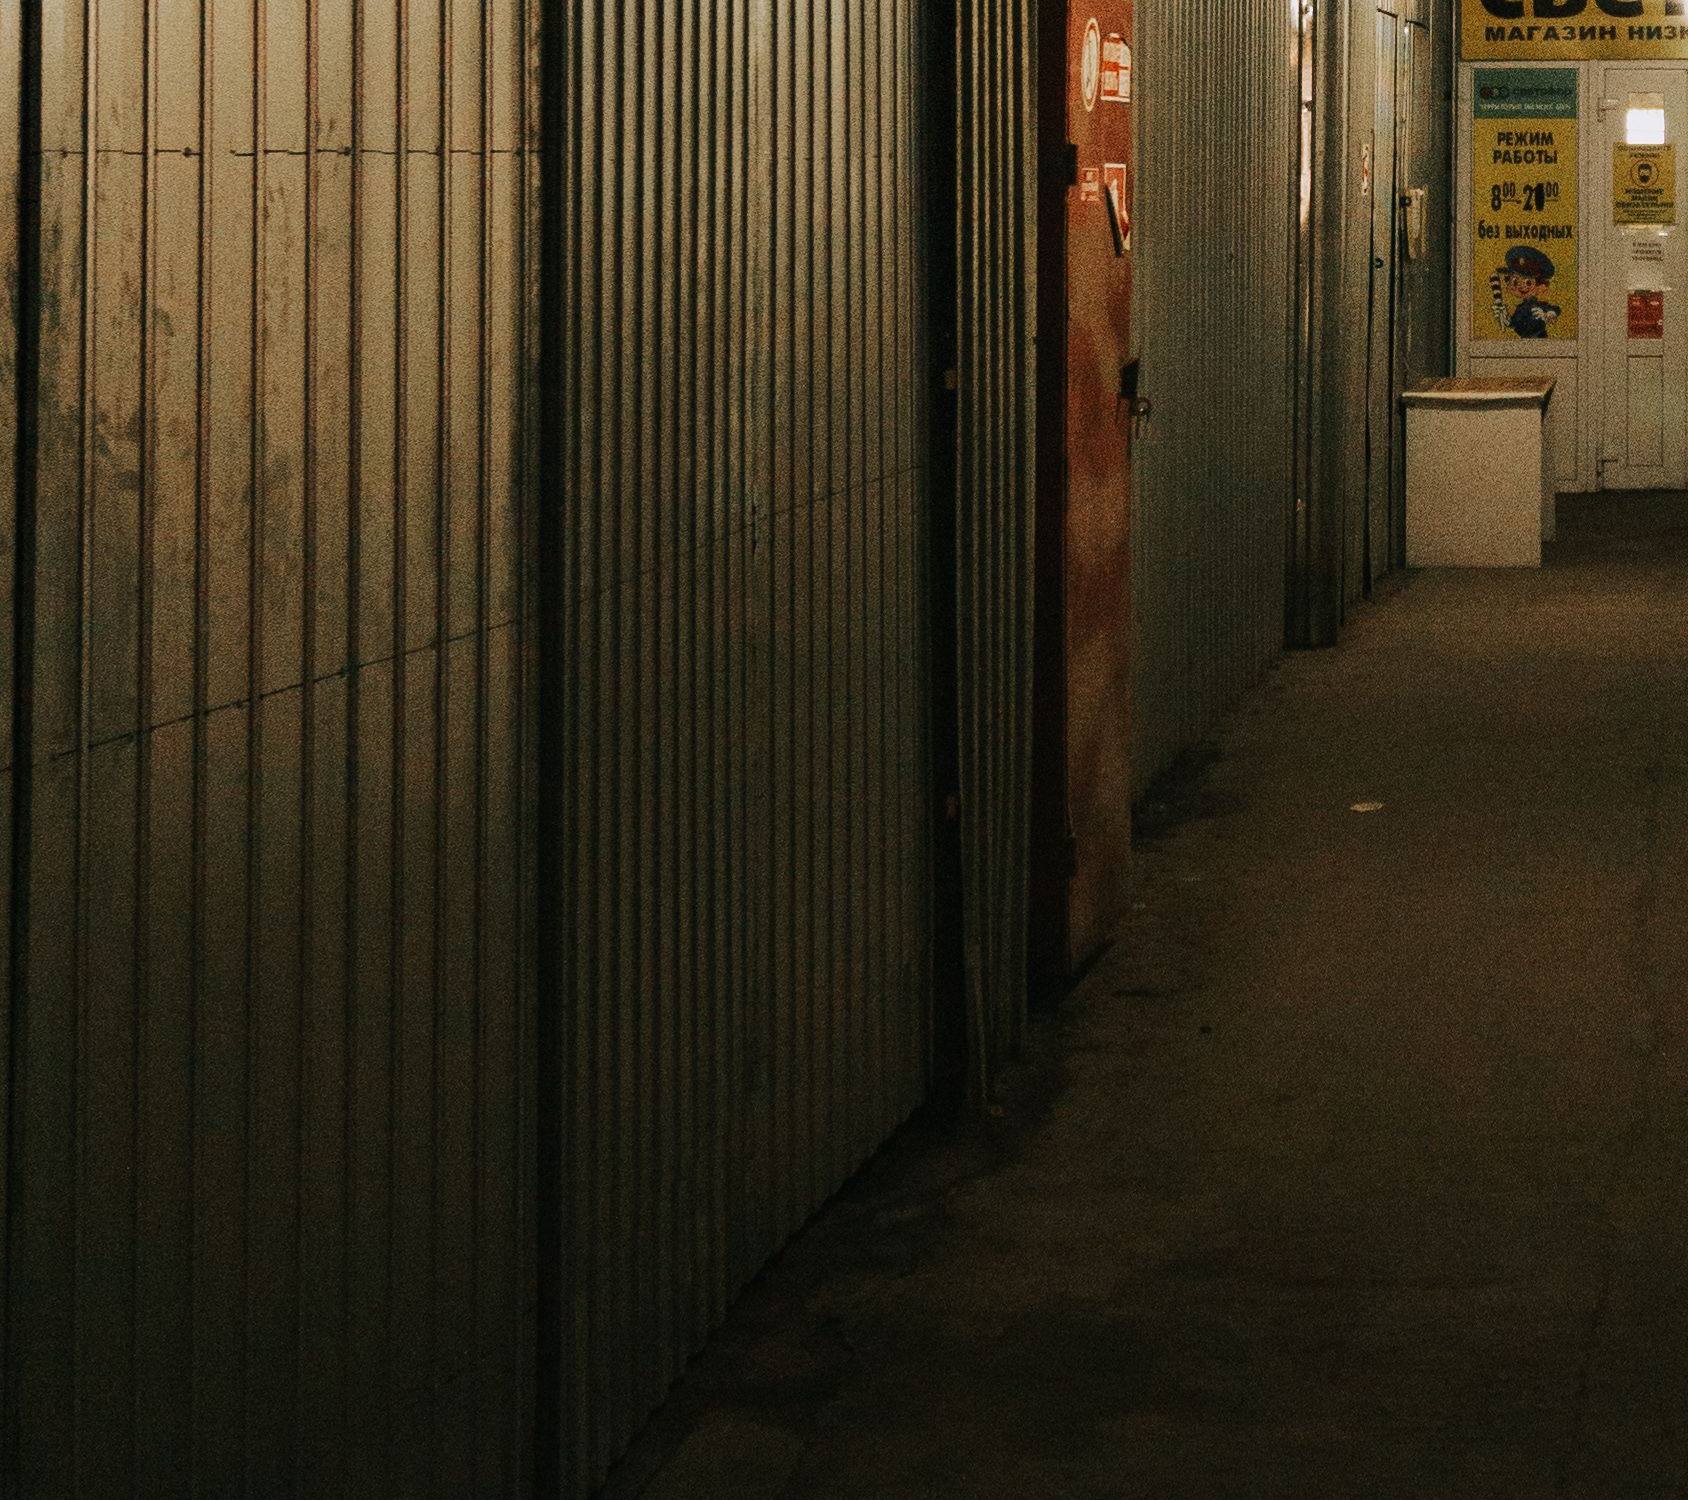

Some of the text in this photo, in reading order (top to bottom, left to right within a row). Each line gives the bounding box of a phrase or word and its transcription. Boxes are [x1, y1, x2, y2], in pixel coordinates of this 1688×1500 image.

[1484, 24, 1617, 42] МАГАЗИН
[1497, 132, 1554, 146] РЕЖИМ
[1493, 150, 1558, 164] РАБОТЫ
[1478, 219, 1573, 241] без выходных
